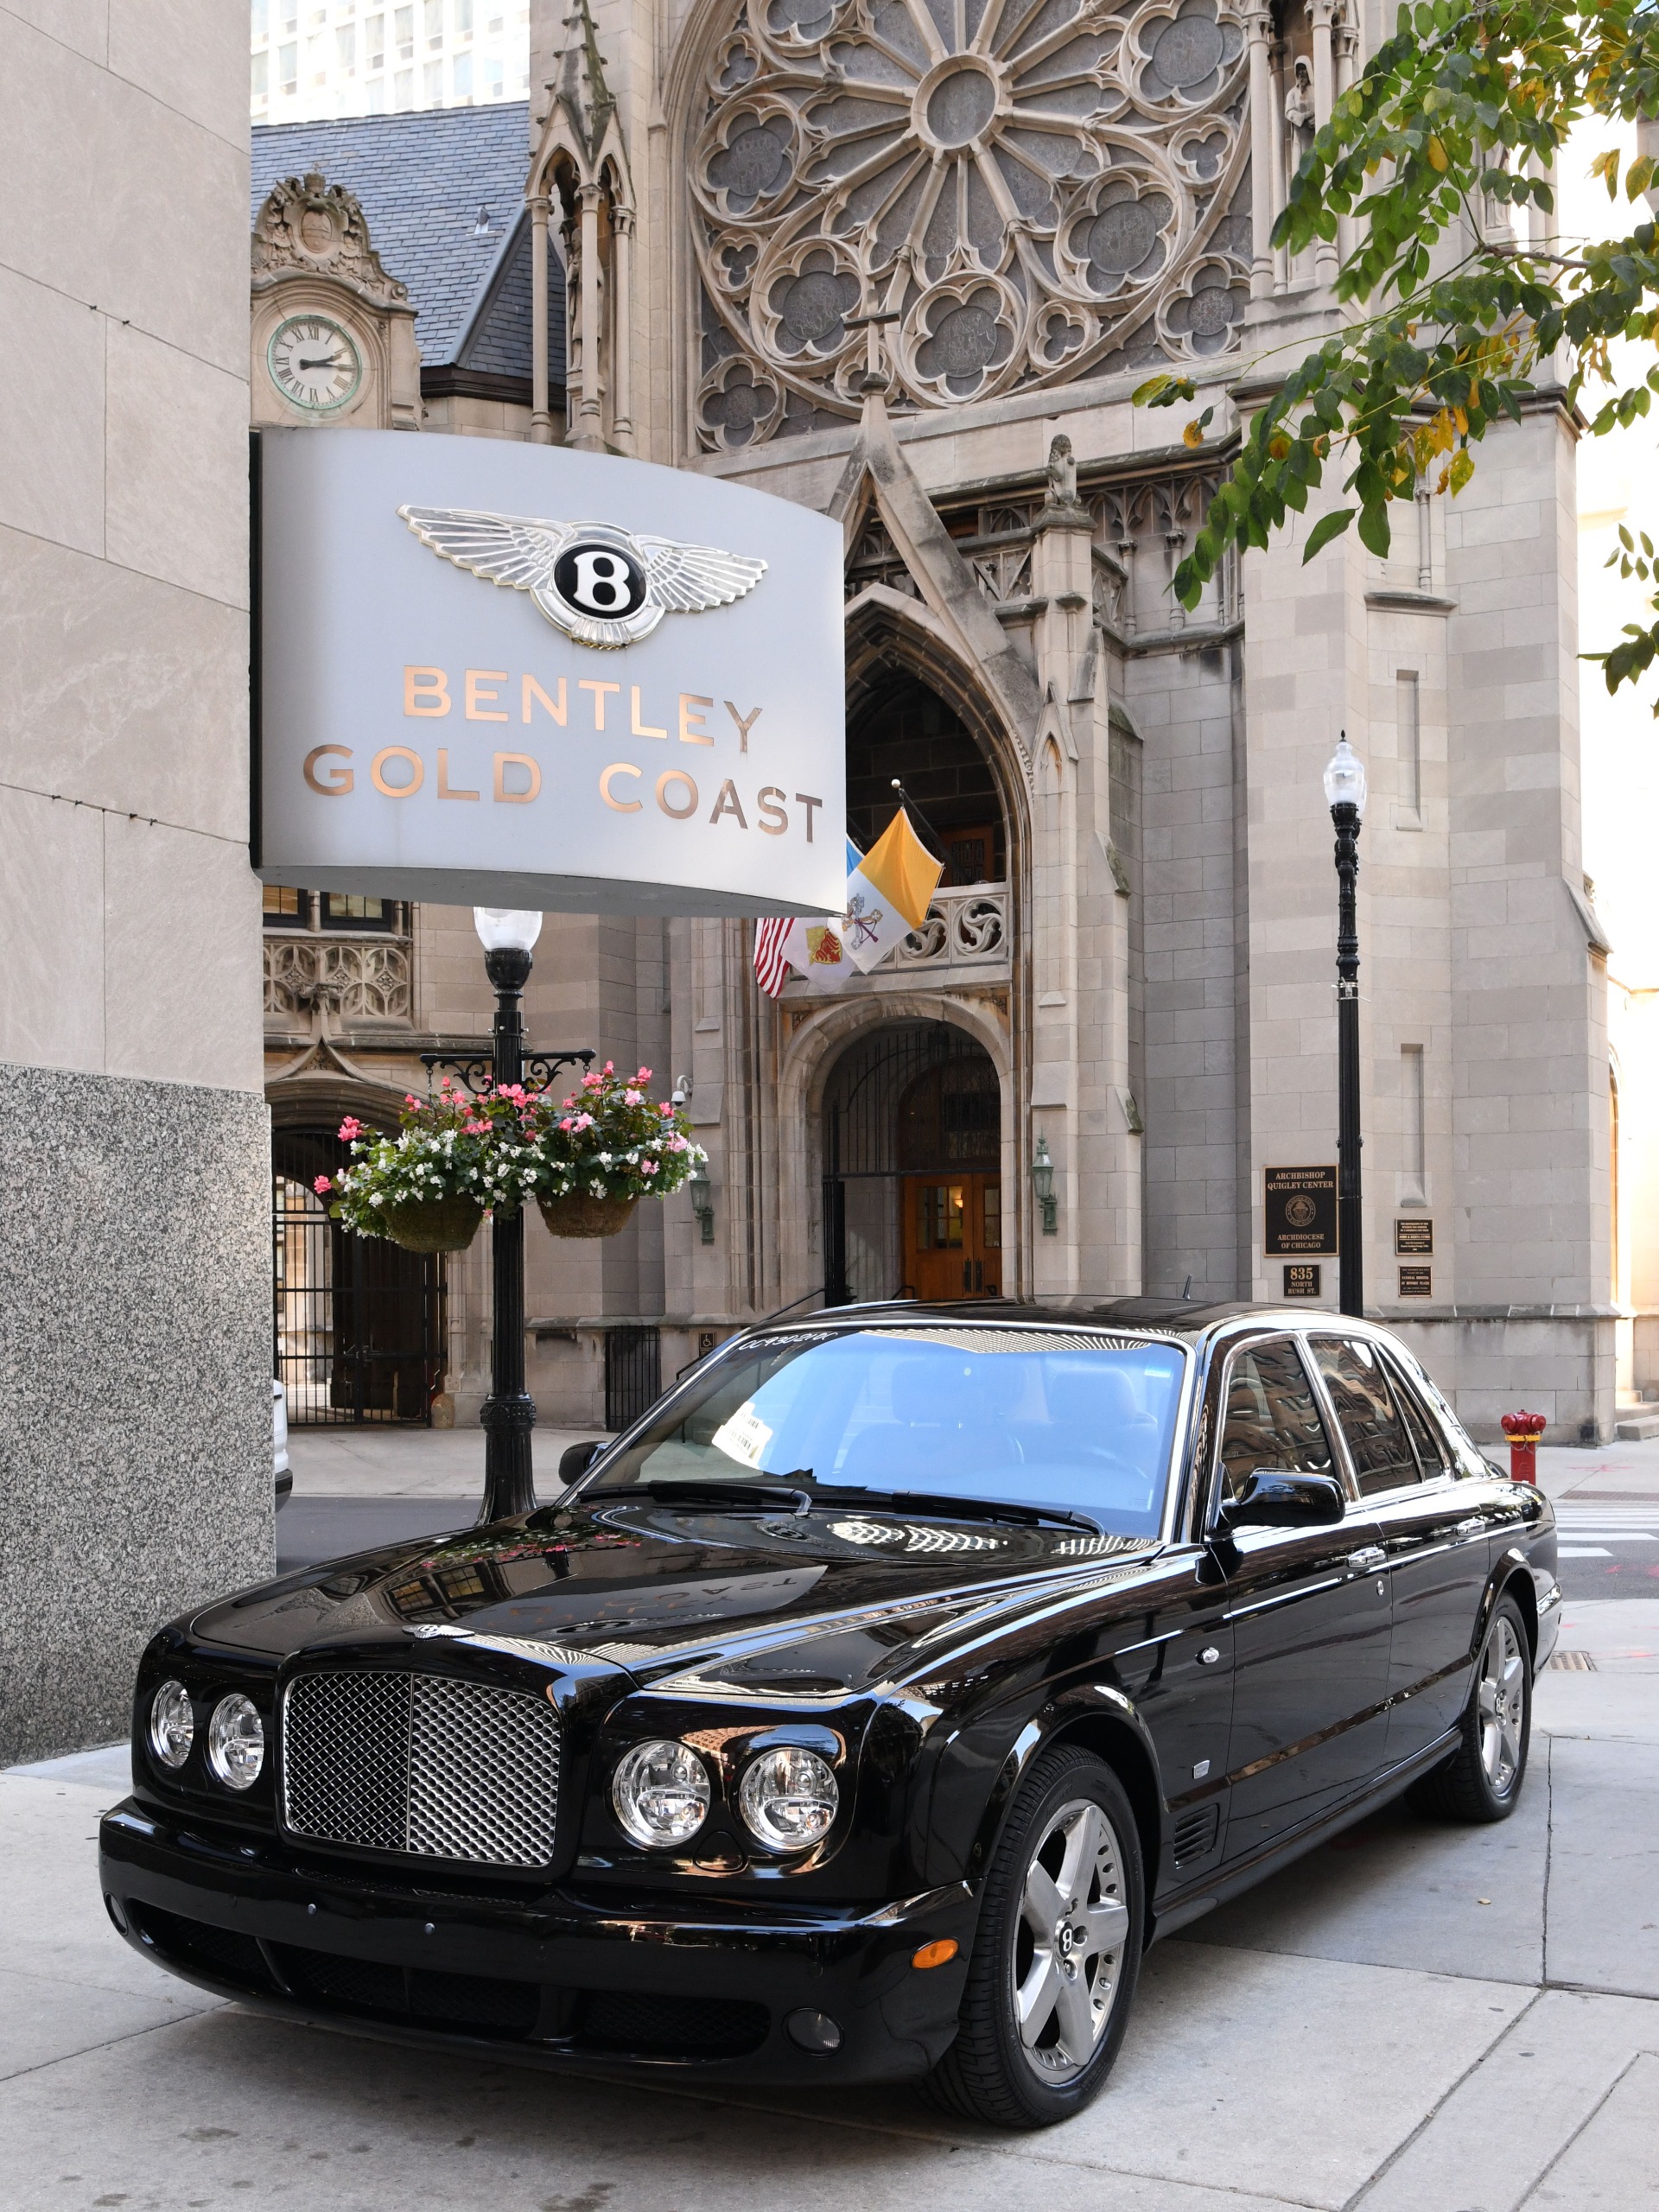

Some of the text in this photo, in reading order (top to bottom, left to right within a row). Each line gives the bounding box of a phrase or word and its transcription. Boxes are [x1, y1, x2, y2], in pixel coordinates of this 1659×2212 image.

[572, 550, 632, 612] B
[403, 664, 763, 753] BENTLEY
[302, 743, 823, 843] GOLD COAST
[1268, 1180, 1334, 1191] QUIGLEY CENTER
[1275, 1171, 1325, 1180] ARCHBISHOP
[1290, 1267, 1313, 1280] 835
